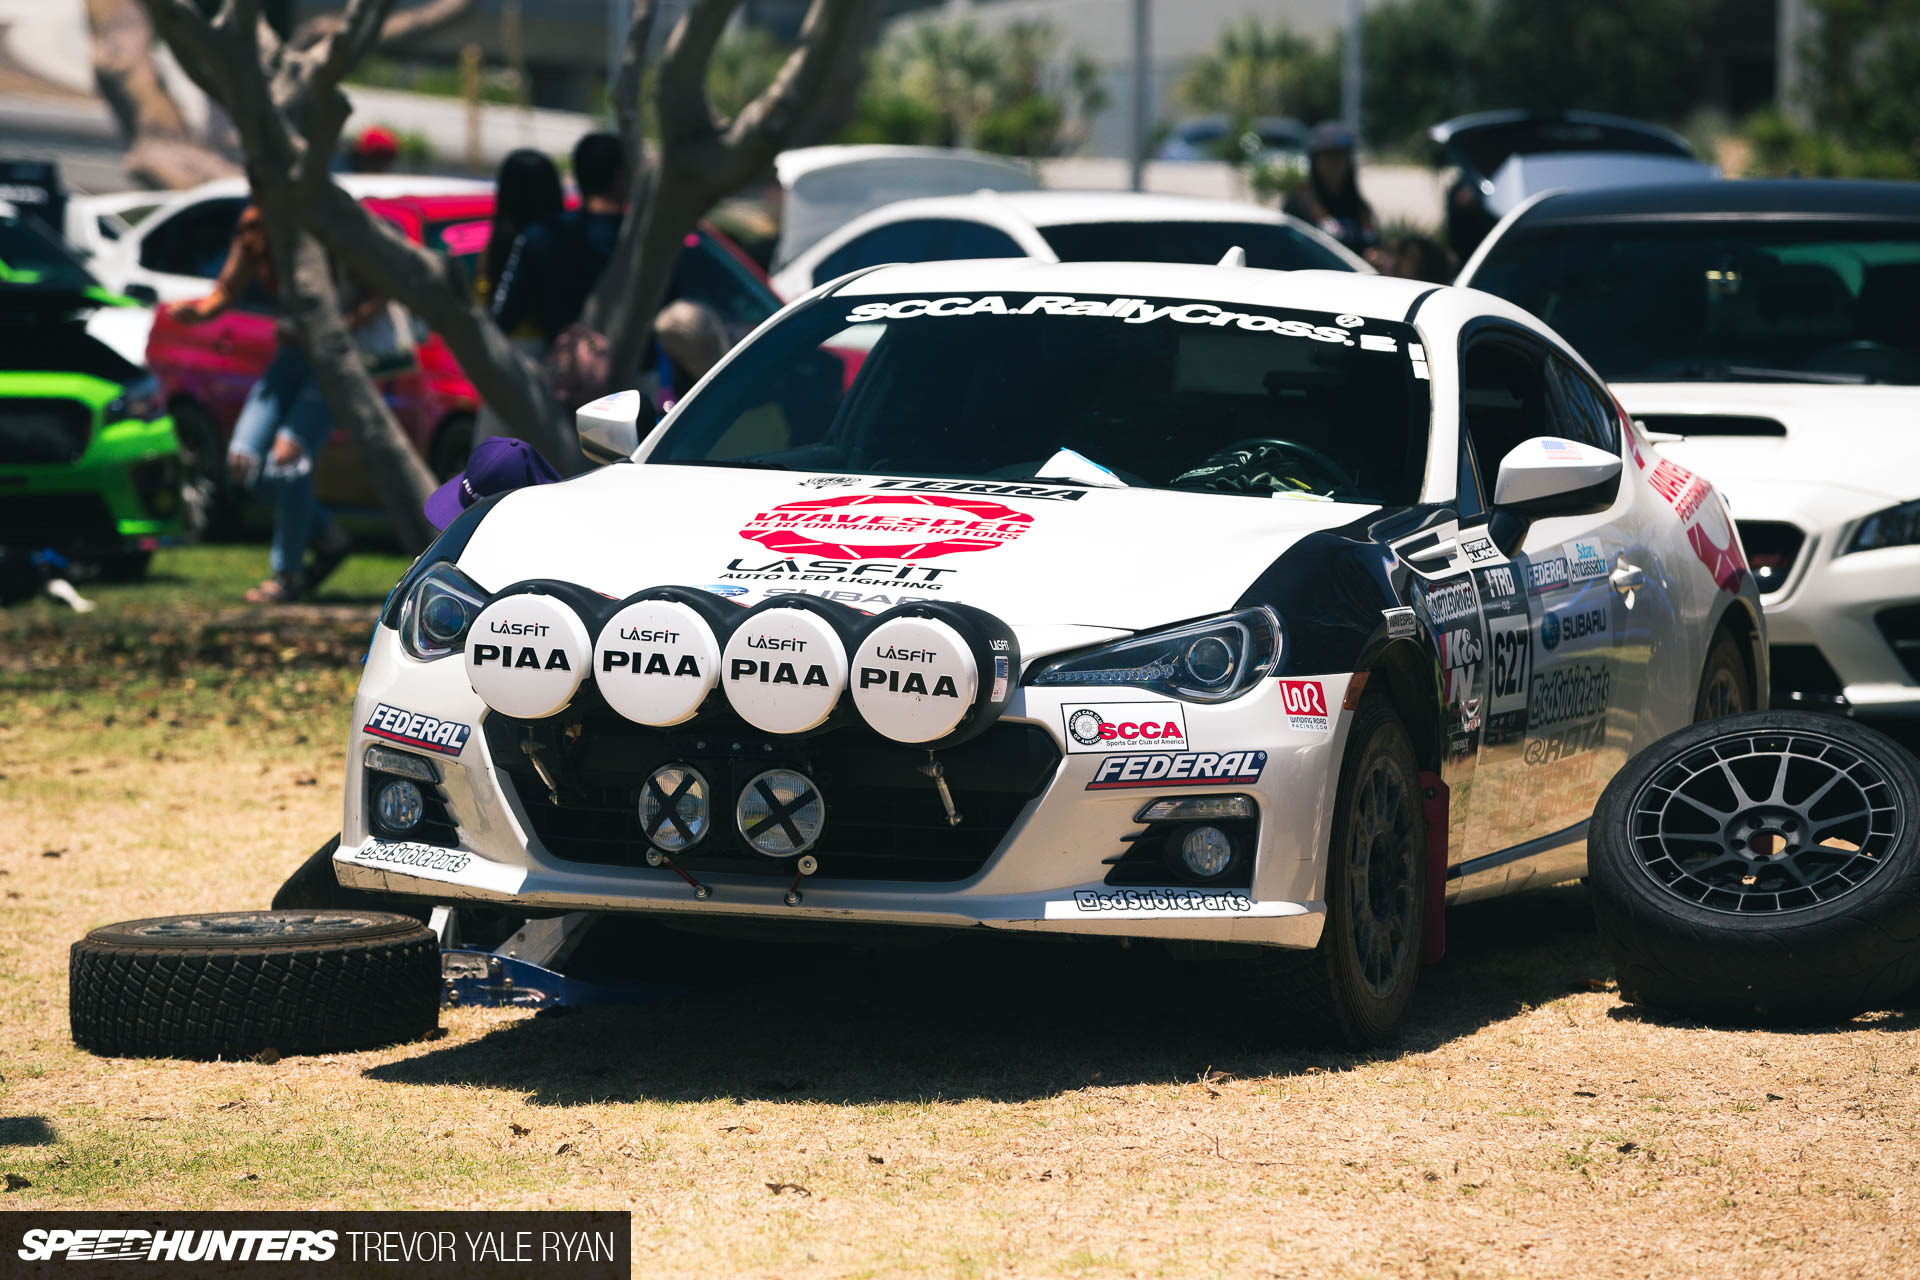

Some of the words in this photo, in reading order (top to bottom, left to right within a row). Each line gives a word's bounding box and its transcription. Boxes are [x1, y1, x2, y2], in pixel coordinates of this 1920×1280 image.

[870, 479, 1088, 501] TERRA
[744, 521, 921, 534] PERFORMANCE
[929, 527, 1021, 540] ROTORS
[754, 513, 1031, 533] WAVESPEC
[718, 573, 781, 581] AUTO
[789, 574, 831, 582] LED
[837, 576, 944, 591] LIGHTING
[1528, 558, 1568, 588] FEDERAL
[1563, 608, 1606, 641] SUBARU
[474, 643, 571, 671] PIAA
[603, 650, 701, 678] PIAA
[1495, 629, 1528, 698] 627
[730, 658, 829, 687] PIAA
[860, 667, 959, 698] PIAA
[368, 704, 464, 748] FEDERAL
[1070, 711, 1082, 730] SPORTS
[1098, 721, 1184, 740] SCCA
[1312, 717, 1327, 725] ROAD
[1080, 736, 1101, 745] AMERIC
[1096, 752, 1260, 781] FEDERAL
